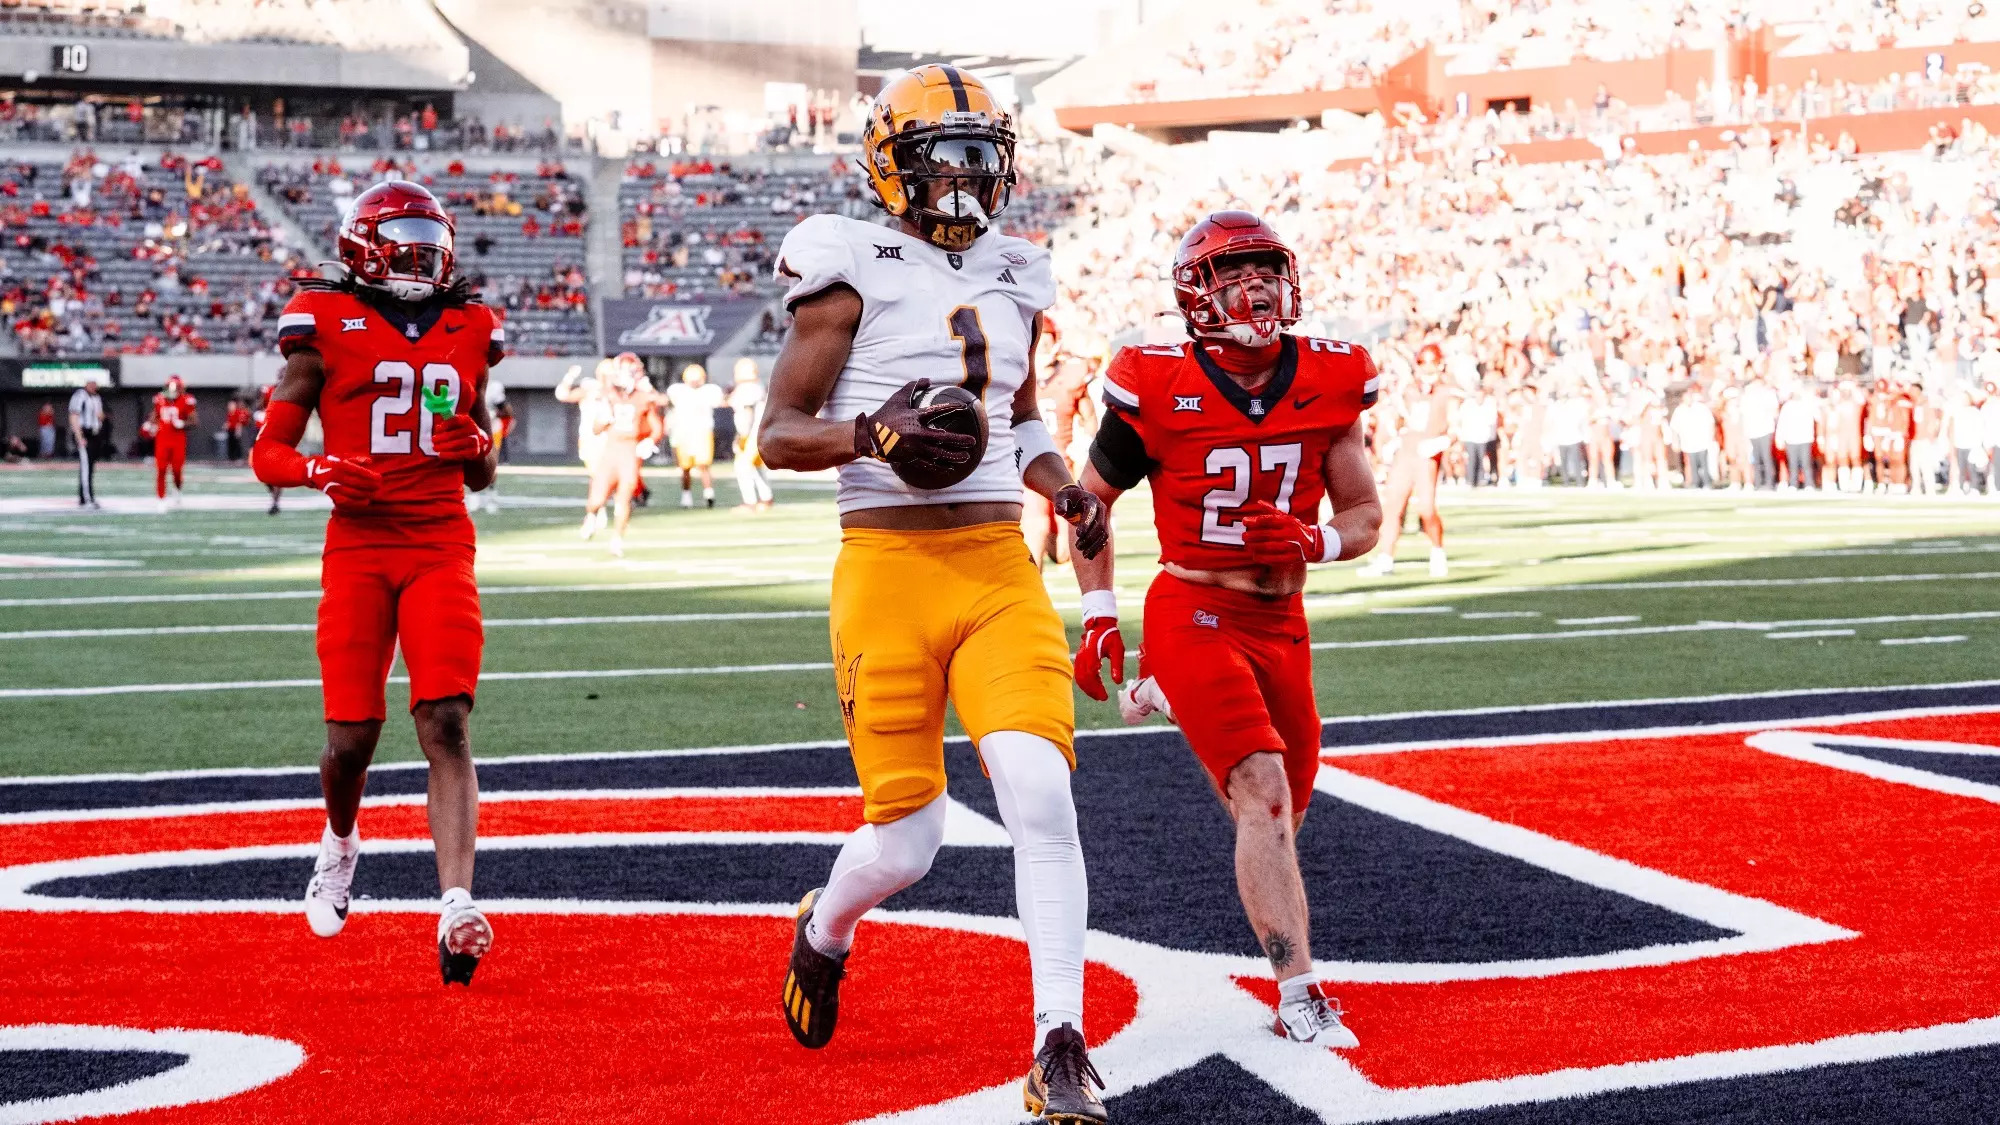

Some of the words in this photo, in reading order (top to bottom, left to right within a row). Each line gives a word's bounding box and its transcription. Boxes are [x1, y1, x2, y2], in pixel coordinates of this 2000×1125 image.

[62, 45, 87, 71] 10
[931, 223, 976, 246] ASU
[873, 243, 905, 261] XII
[341, 317, 367, 332] XII
[945, 304, 992, 409] 1
[1174, 396, 1202, 411] XII
[1201, 442, 1302, 546] 27
